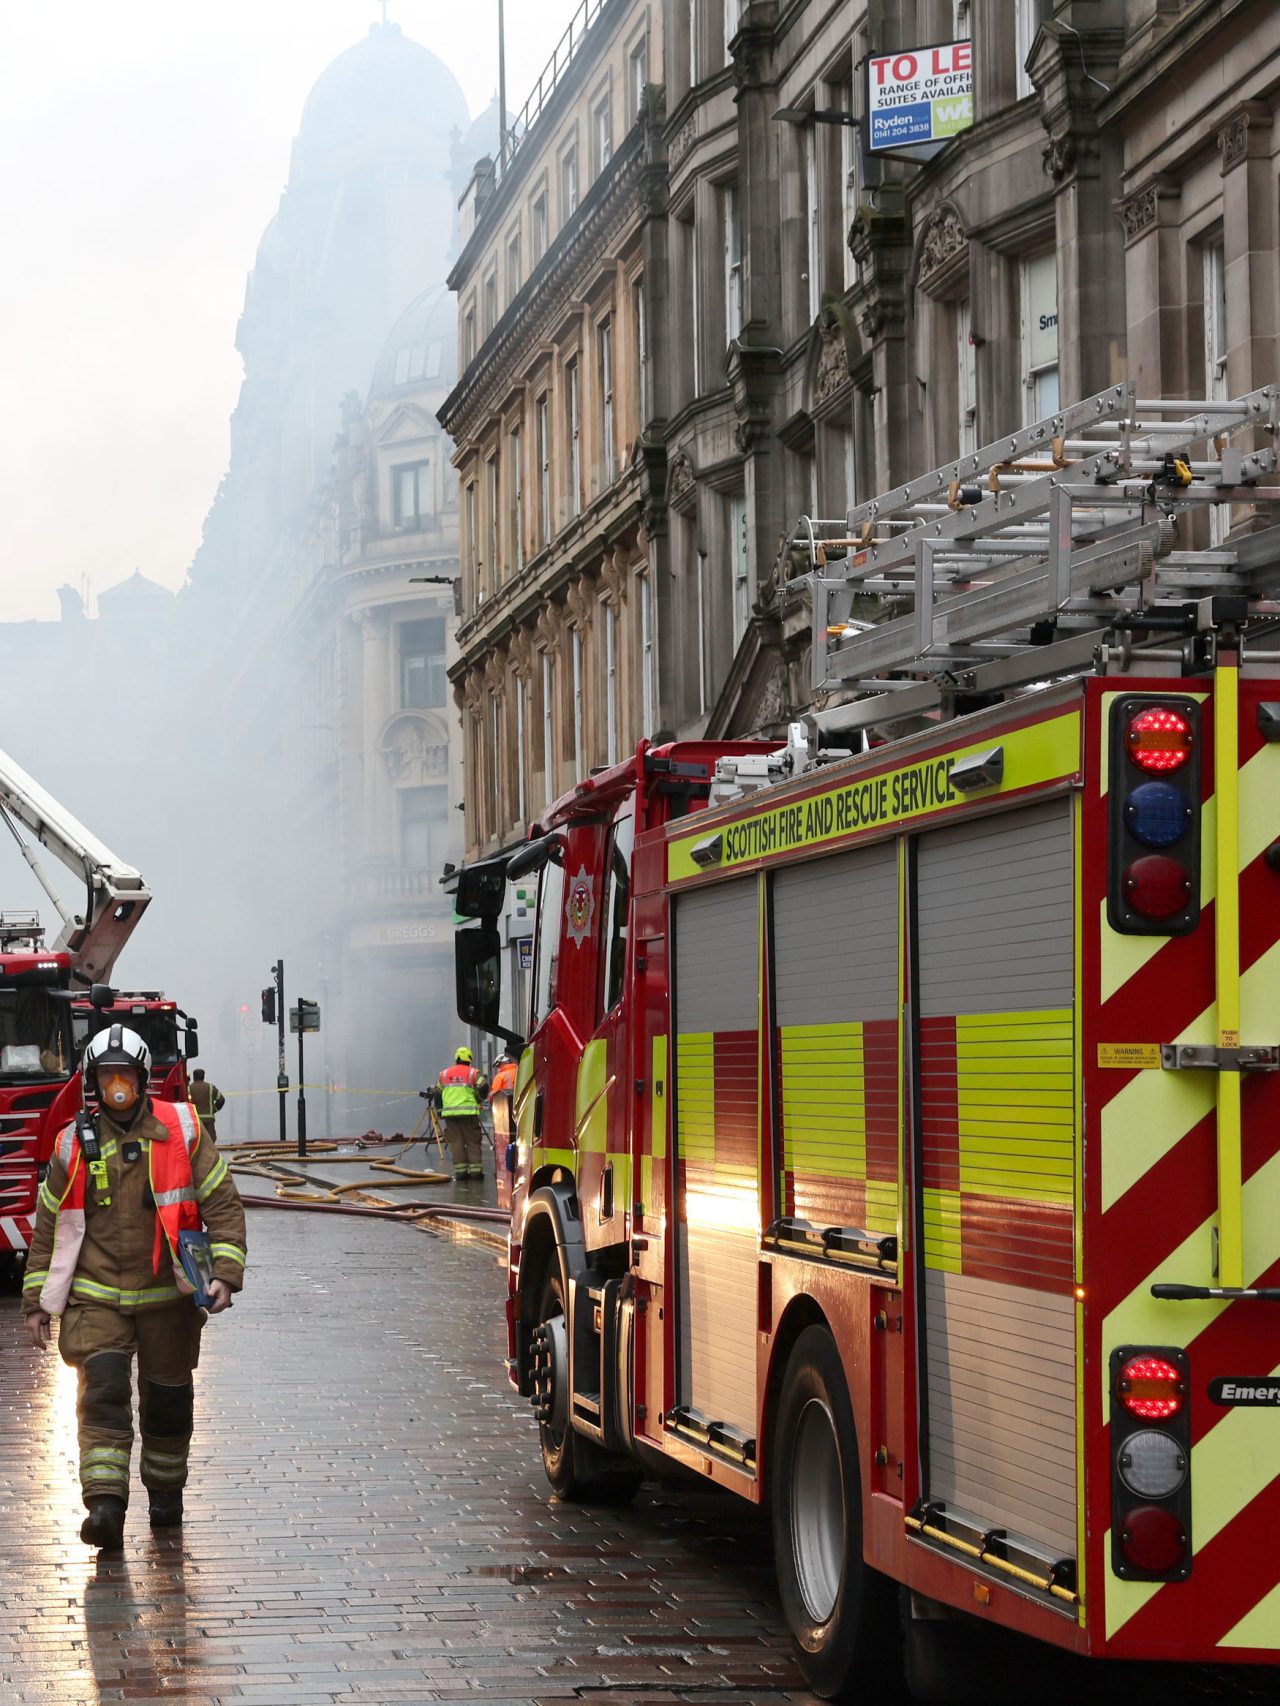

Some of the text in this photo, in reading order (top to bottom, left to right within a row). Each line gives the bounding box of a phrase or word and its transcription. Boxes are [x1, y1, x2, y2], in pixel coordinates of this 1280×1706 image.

[871, 43, 972, 86] TO LE
[879, 72, 972, 96] RANGE OF OFFI
[877, 93, 917, 108] SUITES
[874, 115, 913, 130] Ryden
[874, 129, 891, 139] 0141
[892, 127, 908, 136] 204
[909, 122, 930, 134] 3838
[726, 758, 956, 862] SCOTTISH FIRE AND RESCUE SERVICE
[1114, 1047, 1144, 1055] WARNING
